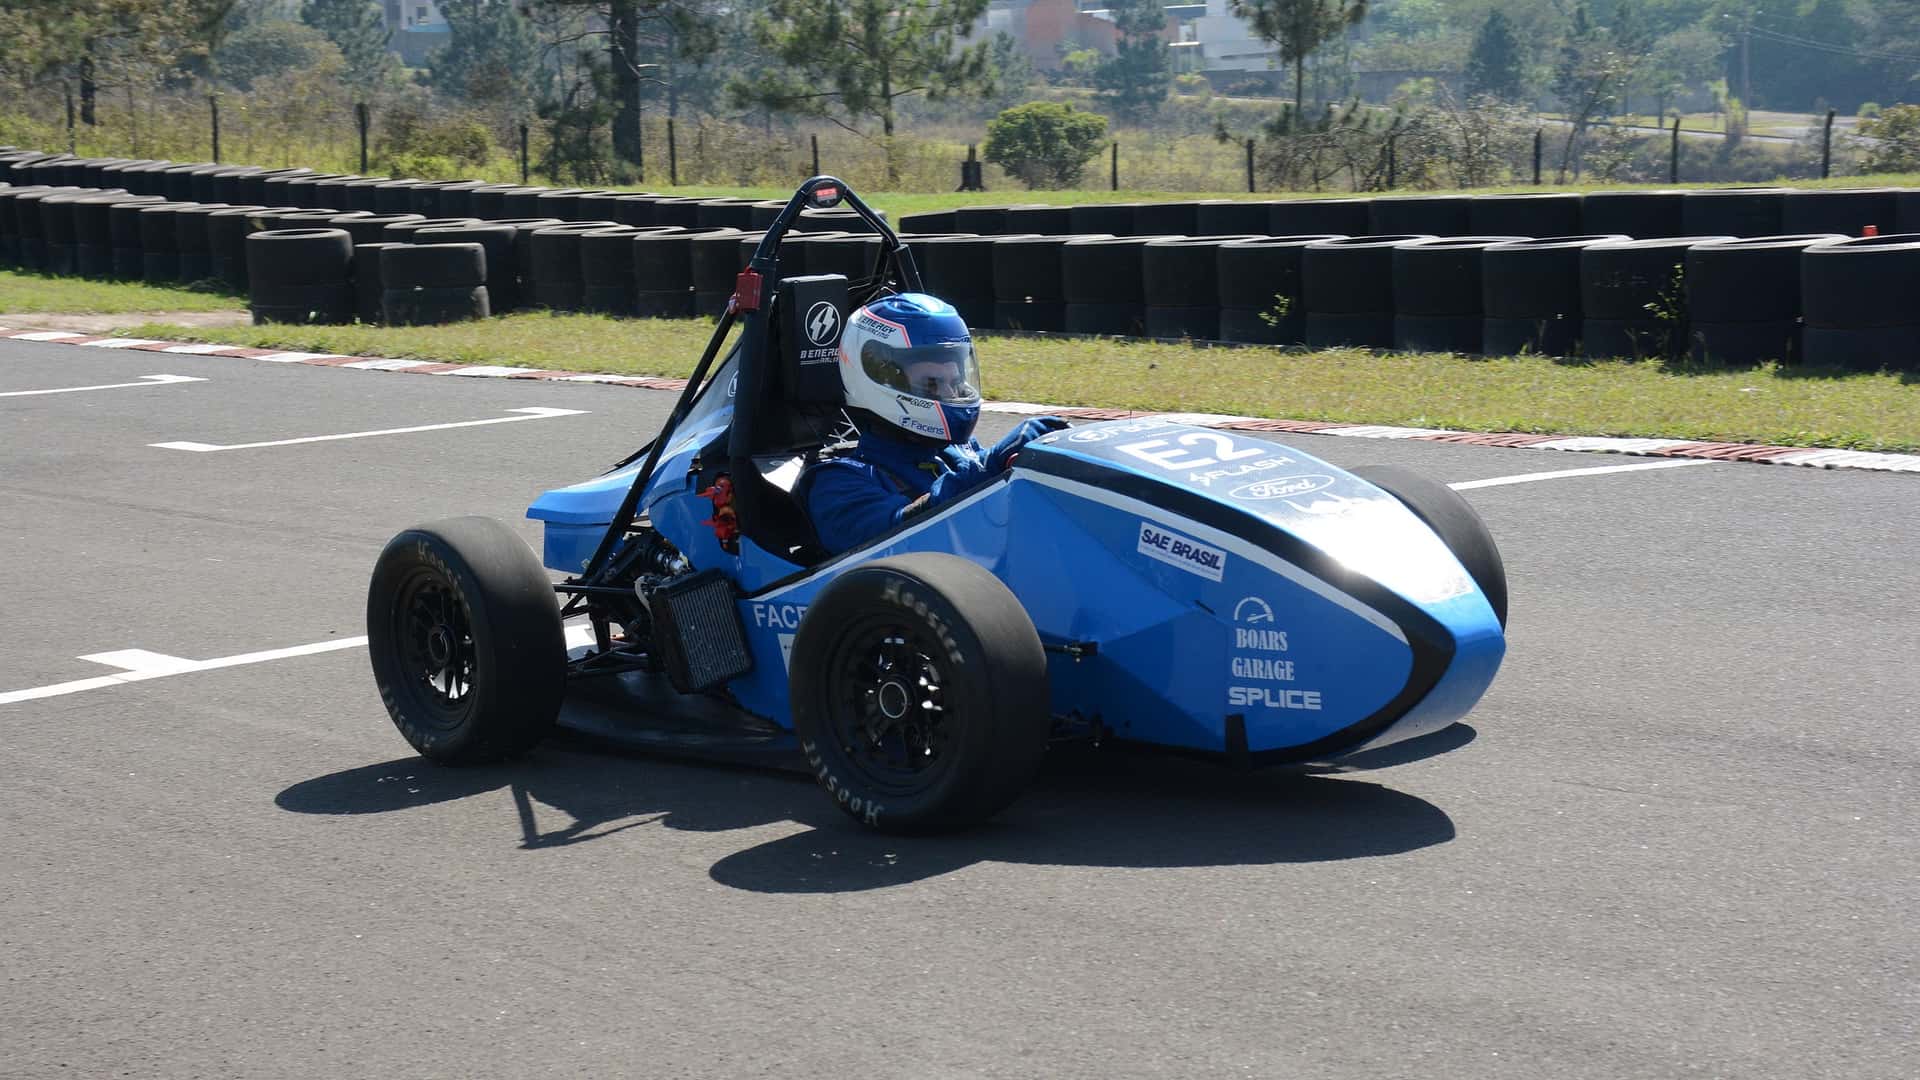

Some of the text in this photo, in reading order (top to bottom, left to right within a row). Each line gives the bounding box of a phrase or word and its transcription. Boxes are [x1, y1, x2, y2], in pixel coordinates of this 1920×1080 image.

[911, 419, 945, 435] Facens
[1116, 432, 1265, 470] E2
[1248, 479, 1317, 498] Ford
[1141, 528, 1172, 551] SAE
[1170, 540, 1221, 570] BRASIL
[752, 604, 809, 629] FACE
[1235, 627, 1288, 651] BOARS
[1231, 656, 1295, 681] GARAGE
[1228, 686, 1322, 710] SPLICE
